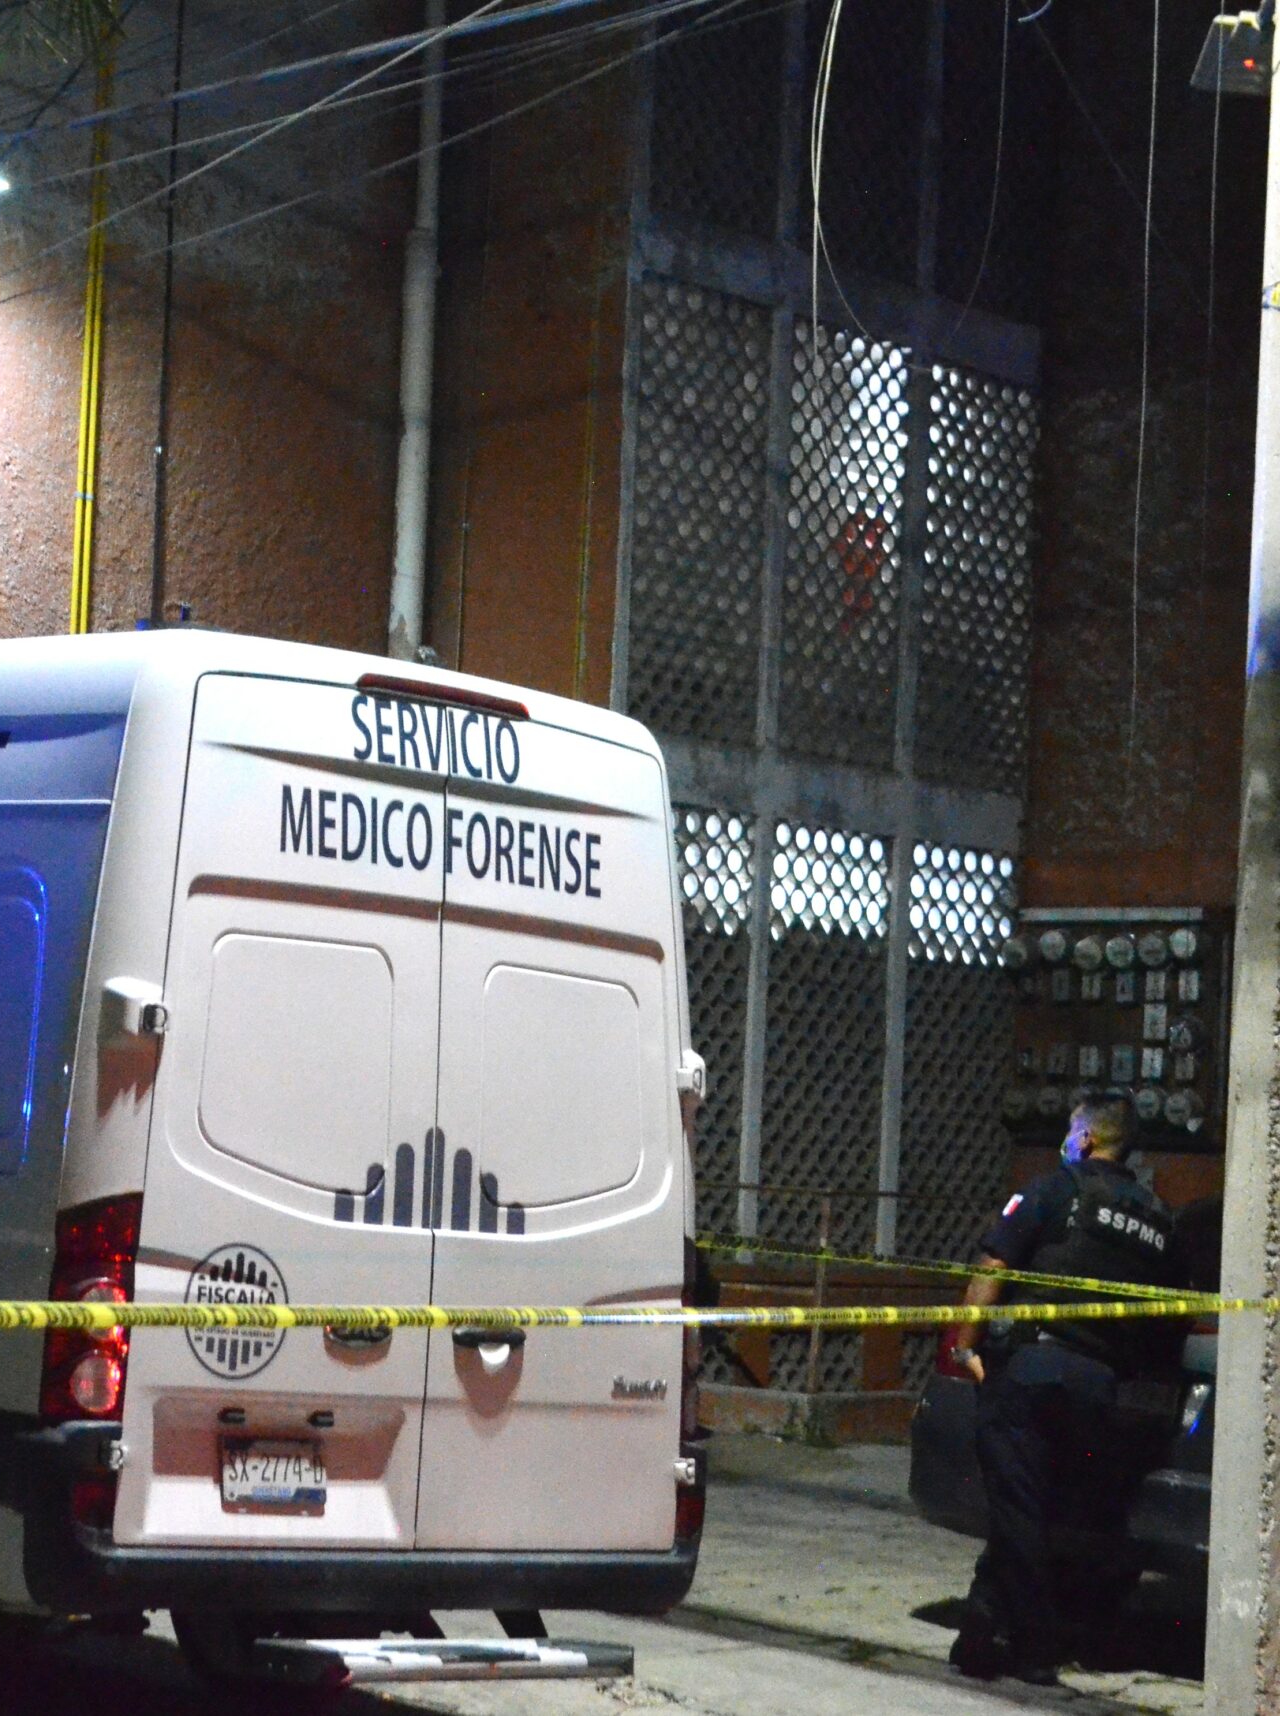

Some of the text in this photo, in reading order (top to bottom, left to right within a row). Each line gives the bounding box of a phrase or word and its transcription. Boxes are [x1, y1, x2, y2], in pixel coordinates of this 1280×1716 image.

[352, 696, 520, 784] SERVICIO
[280, 784, 603, 898] MEDICO FORENSE
